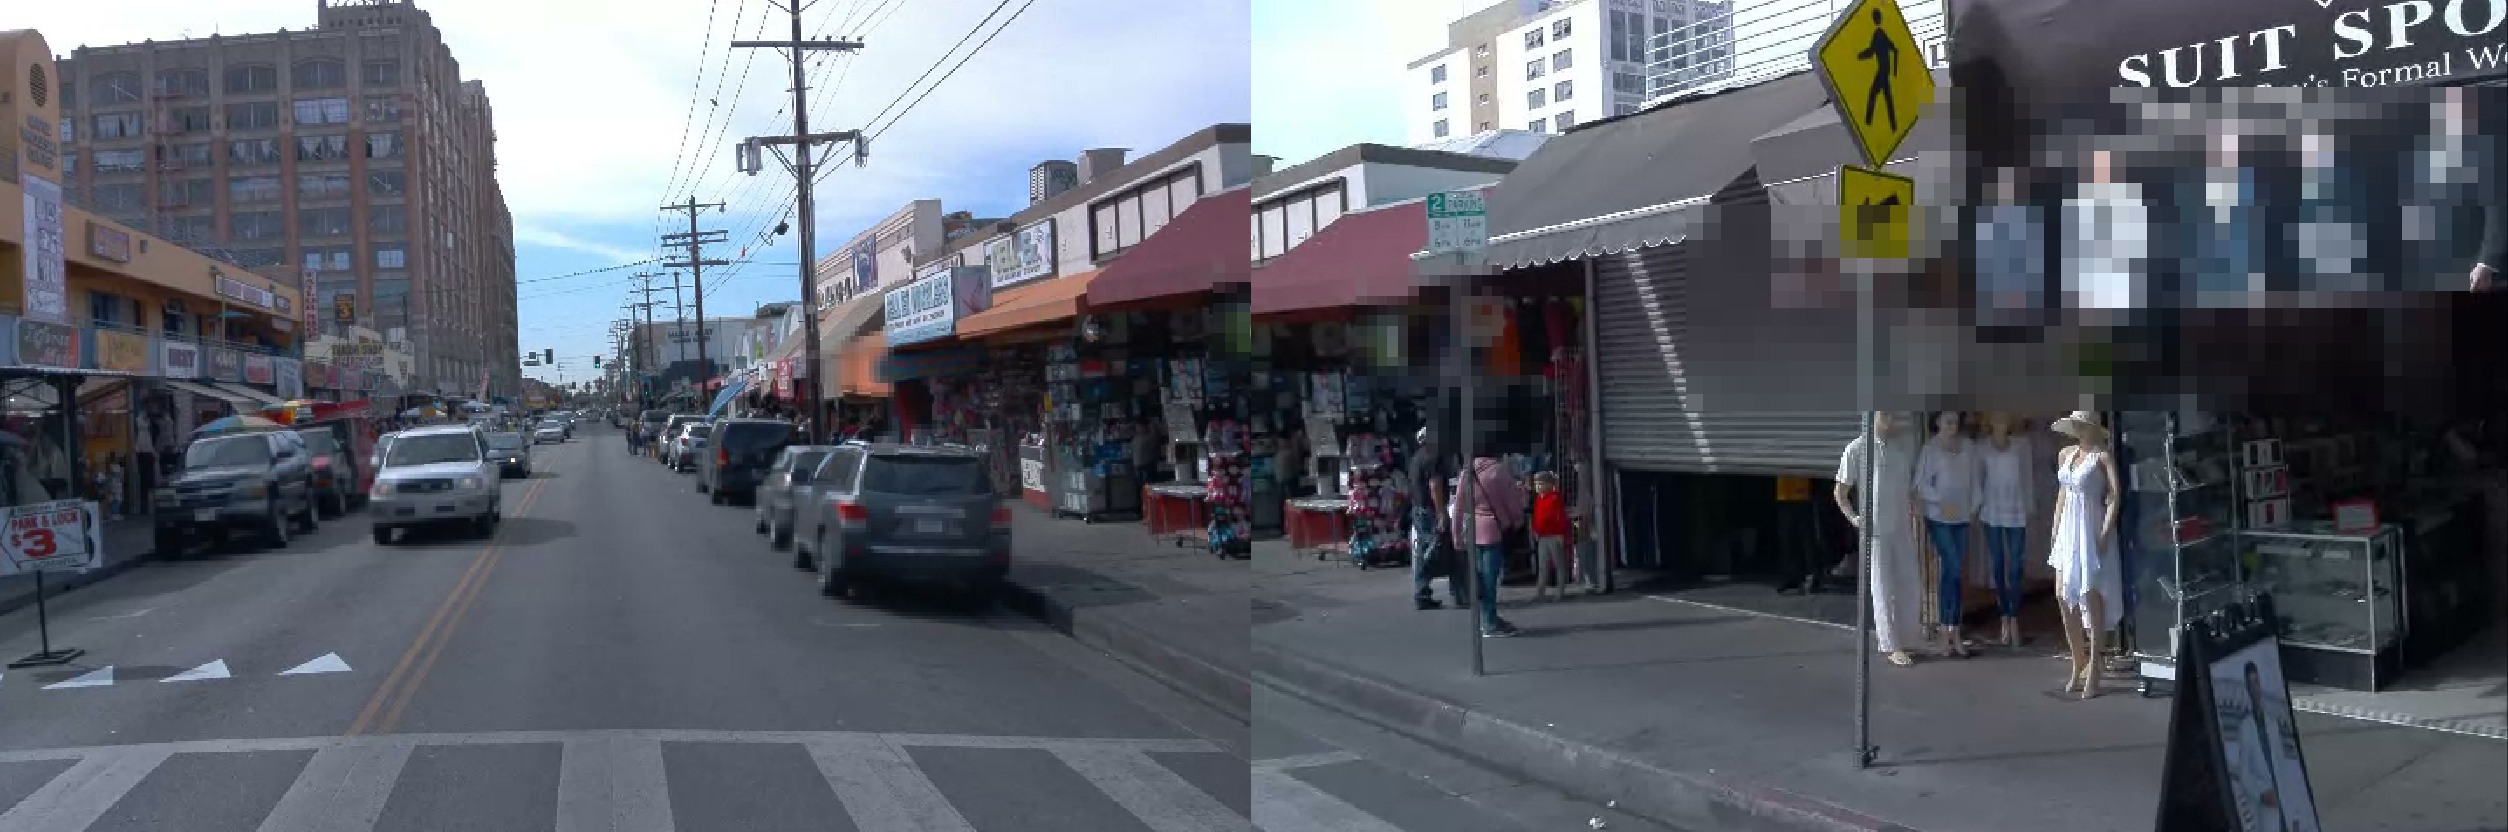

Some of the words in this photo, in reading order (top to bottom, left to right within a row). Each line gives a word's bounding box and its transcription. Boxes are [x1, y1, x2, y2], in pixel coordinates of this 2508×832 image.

[2118, 24, 2296, 87] SUIT
[2342, 51, 2453, 87] Formal
[2465, 43, 2508, 70] W
[1430, 194, 1443, 210] 2
